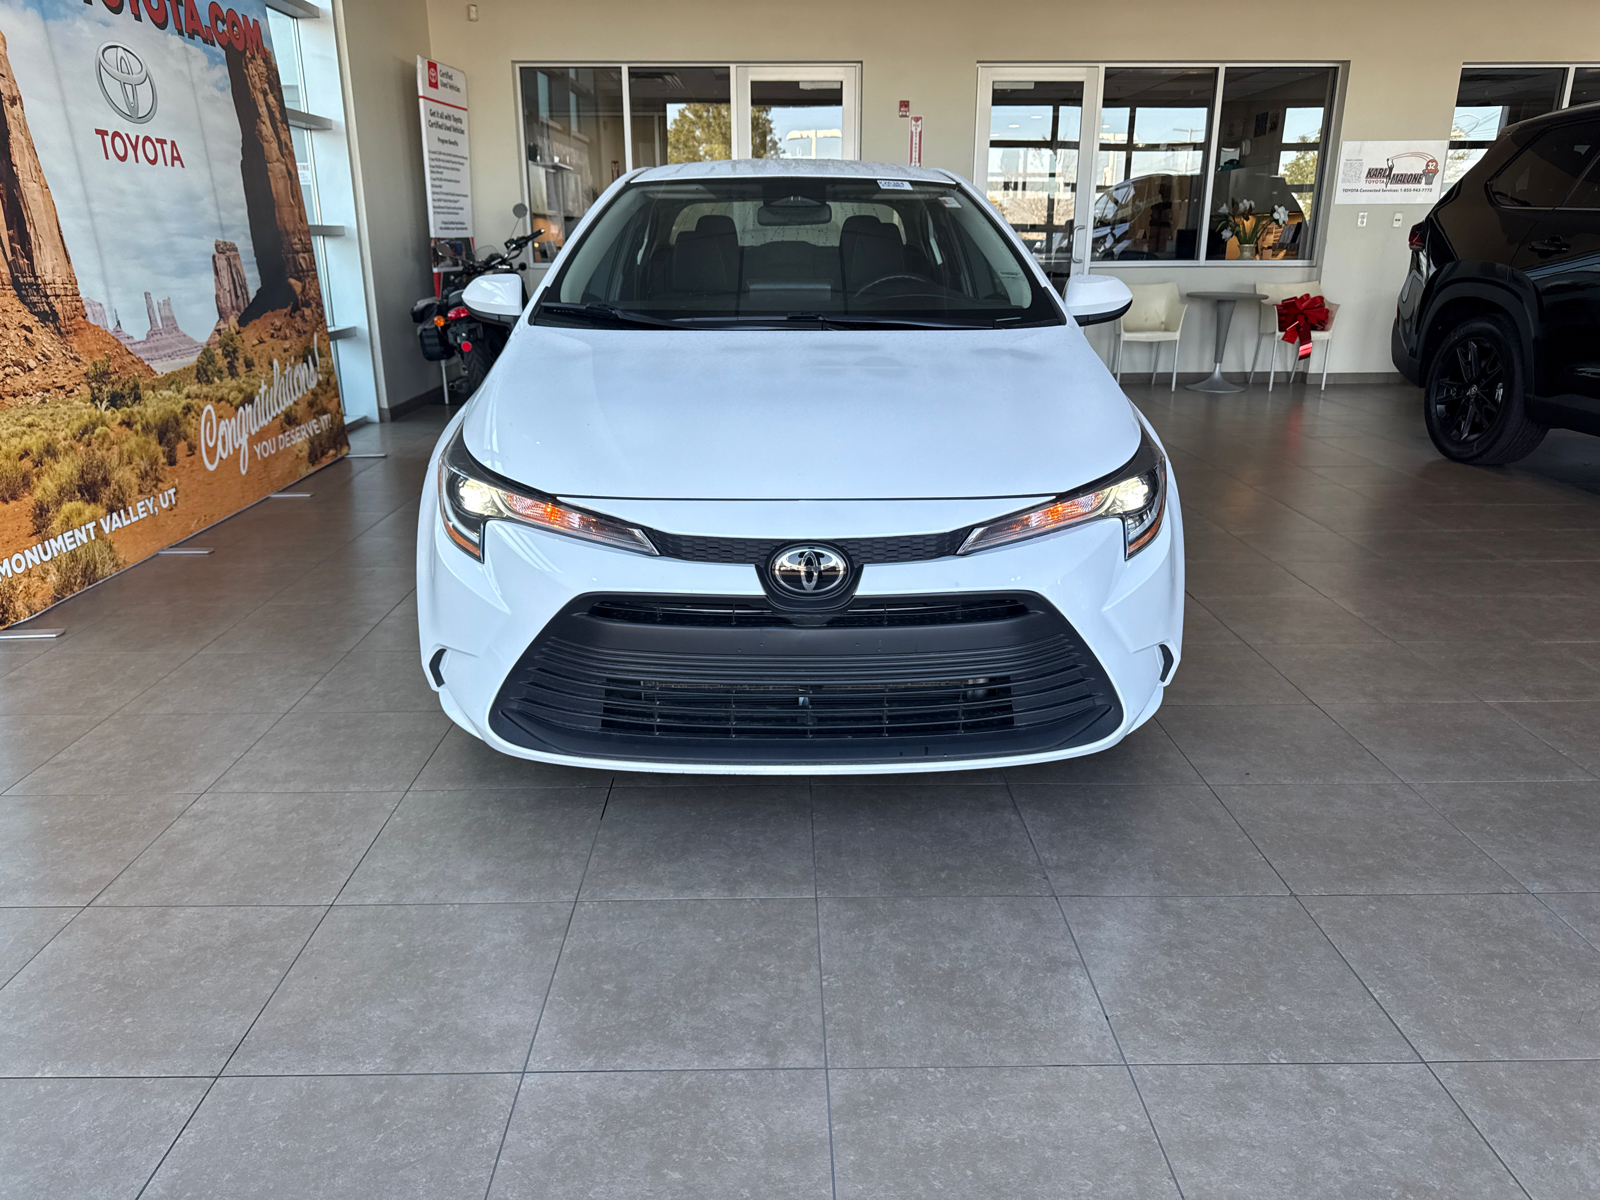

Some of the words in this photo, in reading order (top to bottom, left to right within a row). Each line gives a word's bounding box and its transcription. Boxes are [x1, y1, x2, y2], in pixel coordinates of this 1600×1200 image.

[95, 128, 185, 168] TOYOTA
[1427, 162, 1436, 170] 32
[1366, 168, 1389, 178] KARL
[1390, 173, 1424, 184] MALONE
[201, 332, 322, 475] Congratulations!
[253, 437, 276, 460] YOU
[278, 417, 320, 450] DESERVE
[320, 413, 332, 432] IT!
[0, 521, 97, 583] MONUMENT
[99, 496, 159, 535] VALLEY,
[159, 487, 177, 509] UT
